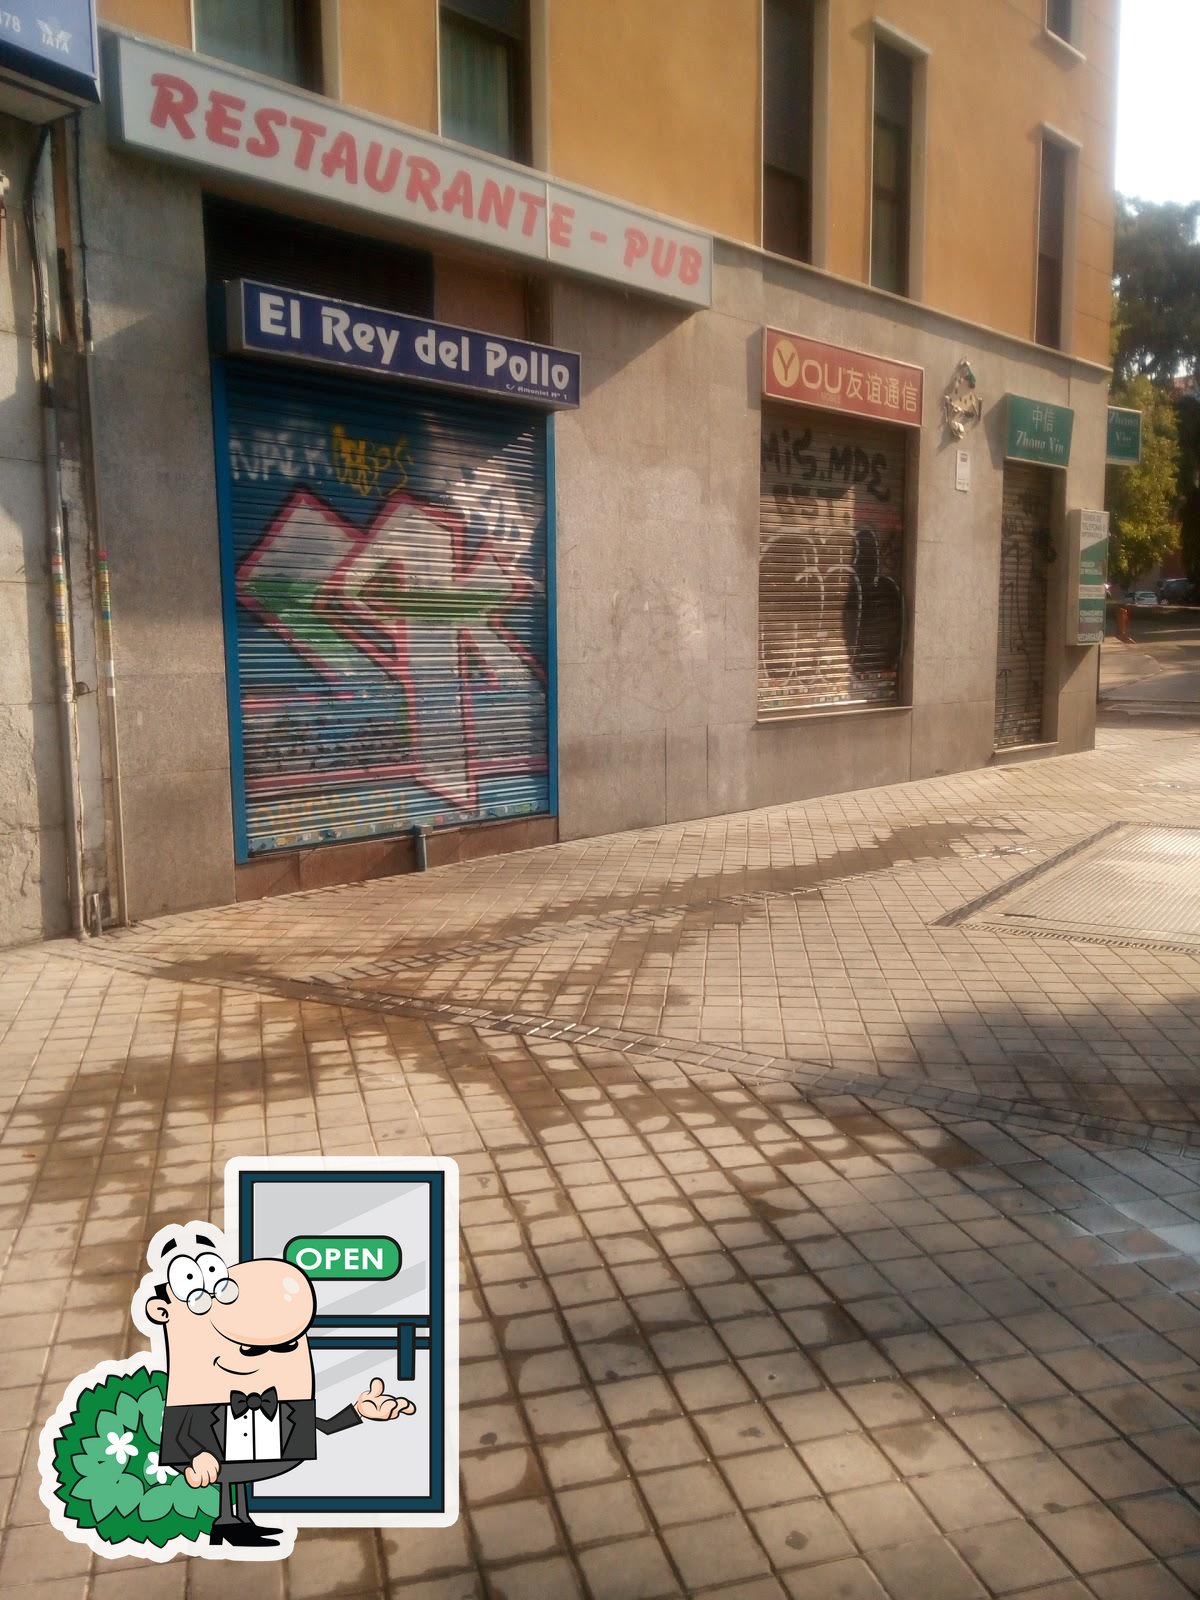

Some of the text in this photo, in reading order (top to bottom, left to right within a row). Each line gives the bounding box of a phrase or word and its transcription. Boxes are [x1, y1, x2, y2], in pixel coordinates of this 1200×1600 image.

[150, 72, 576, 248] RESTAURANTE
[623, 226, 702, 286] PUB
[259, 292, 570, 390] El Rey del Pollo
